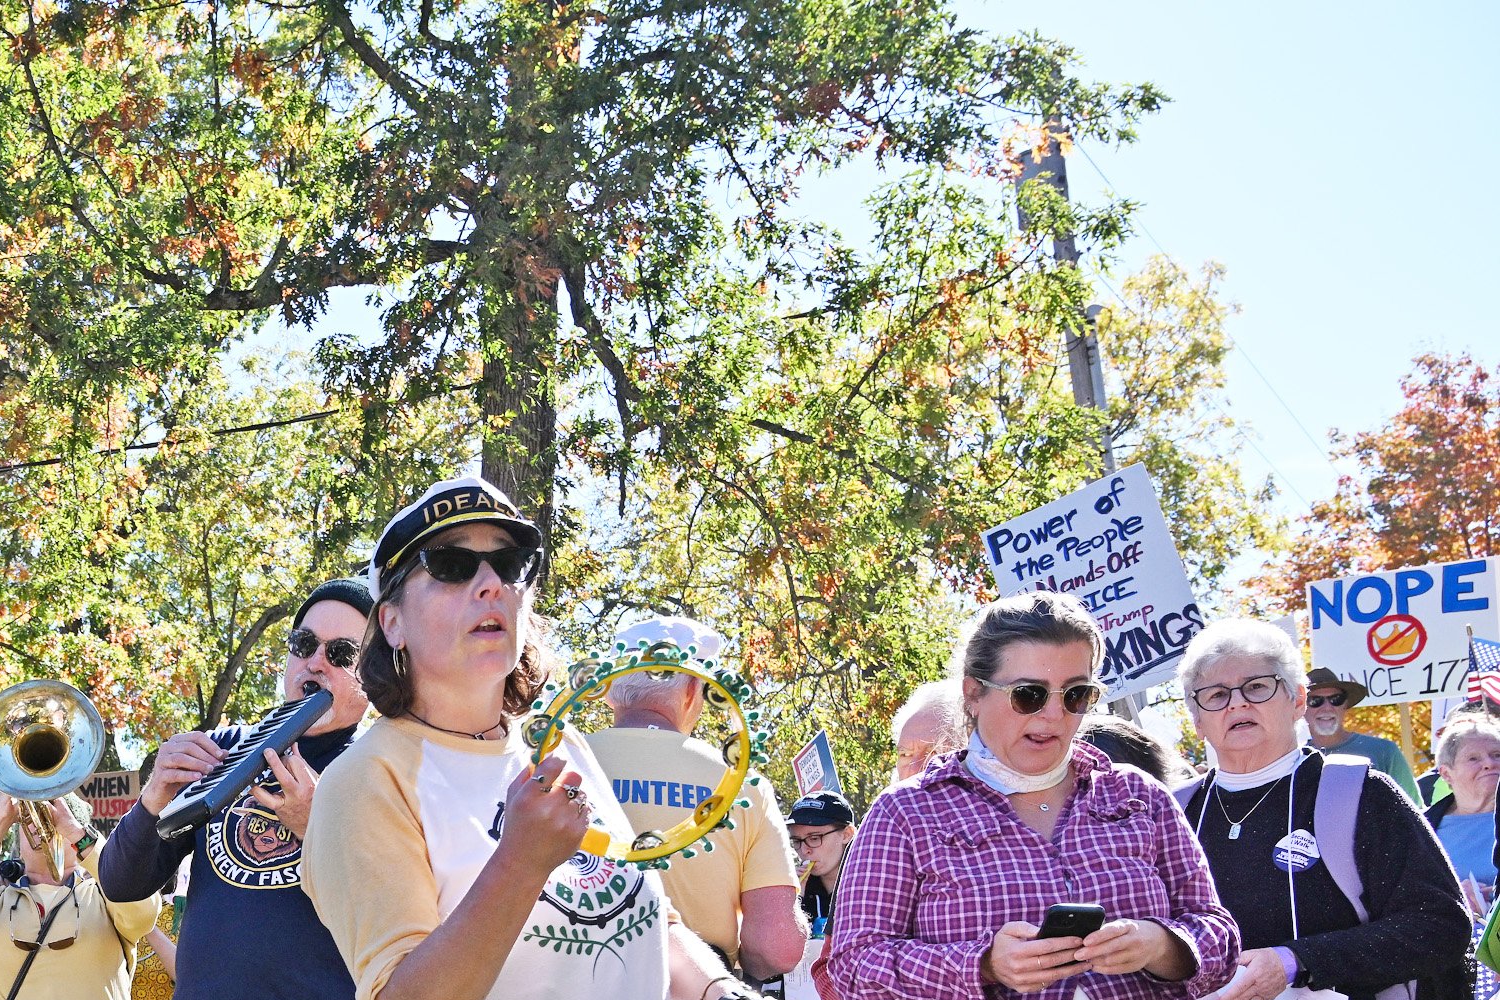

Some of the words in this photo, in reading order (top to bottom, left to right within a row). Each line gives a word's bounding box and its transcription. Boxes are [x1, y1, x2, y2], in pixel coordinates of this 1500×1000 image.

[987, 508, 1077, 565] Power
[1094, 477, 1125, 514] of
[1011, 553, 1054, 581] the
[1056, 516, 1144, 561] People
[1107, 541, 1144, 574] Off
[1310, 560, 1489, 629] NOPE
[1097, 604, 1154, 629] Trump
[1105, 603, 1205, 675] KINGS
[1419, 657, 1469, 695] 177
[80, 775, 130, 798] WHEN
[613, 778, 712, 809] UNTEER
[209, 822, 254, 884] PREVENT
[1295, 840, 1309, 850] Walk
[555, 874, 627, 911] BAND
